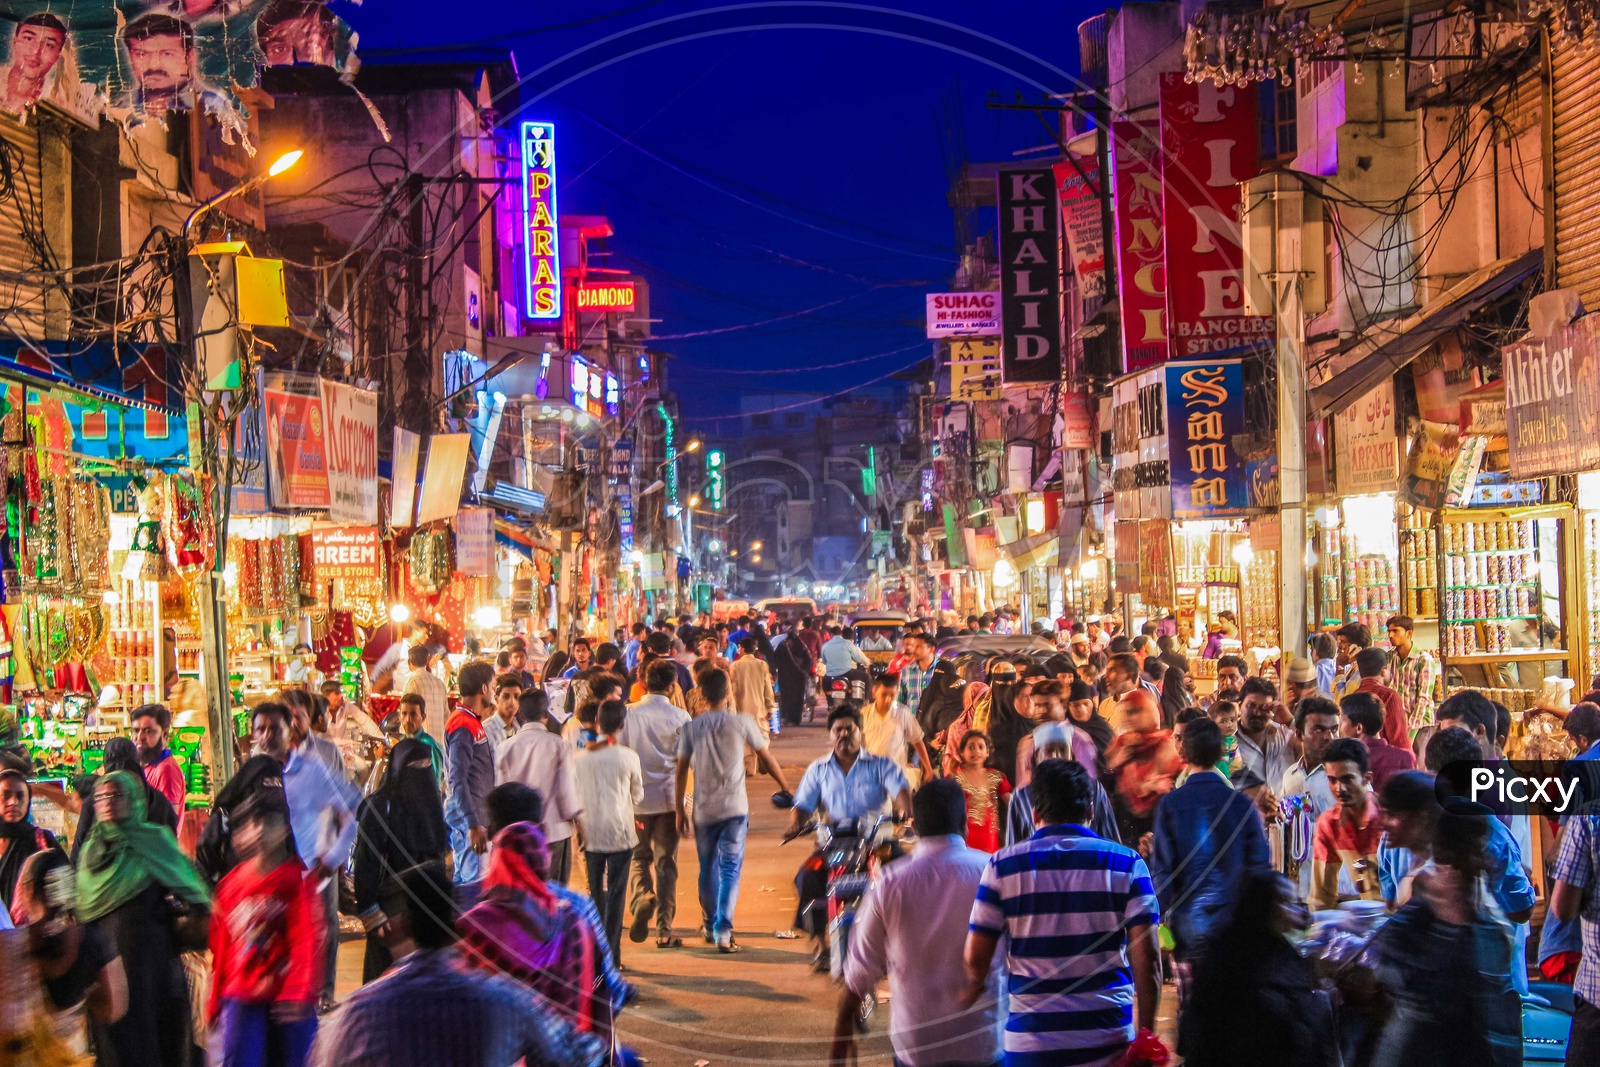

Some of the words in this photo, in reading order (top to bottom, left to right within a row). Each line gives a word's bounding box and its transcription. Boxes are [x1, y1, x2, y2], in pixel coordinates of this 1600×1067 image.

[530, 172, 555, 313] PARAS
[1010, 174, 1050, 361] KHALID
[577, 287, 634, 307] DIAMOND
[934, 294, 995, 309] SUHAG
[937, 310, 992, 320] HI-FASHION
[1177, 318, 1276, 338] BANGLES
[1505, 340, 1574, 410] Akhter
[322, 382, 377, 480] Kareem
[1517, 405, 1568, 449] Jewellers
[459, 540, 493, 548] General
[344, 566, 375, 577] STORE
